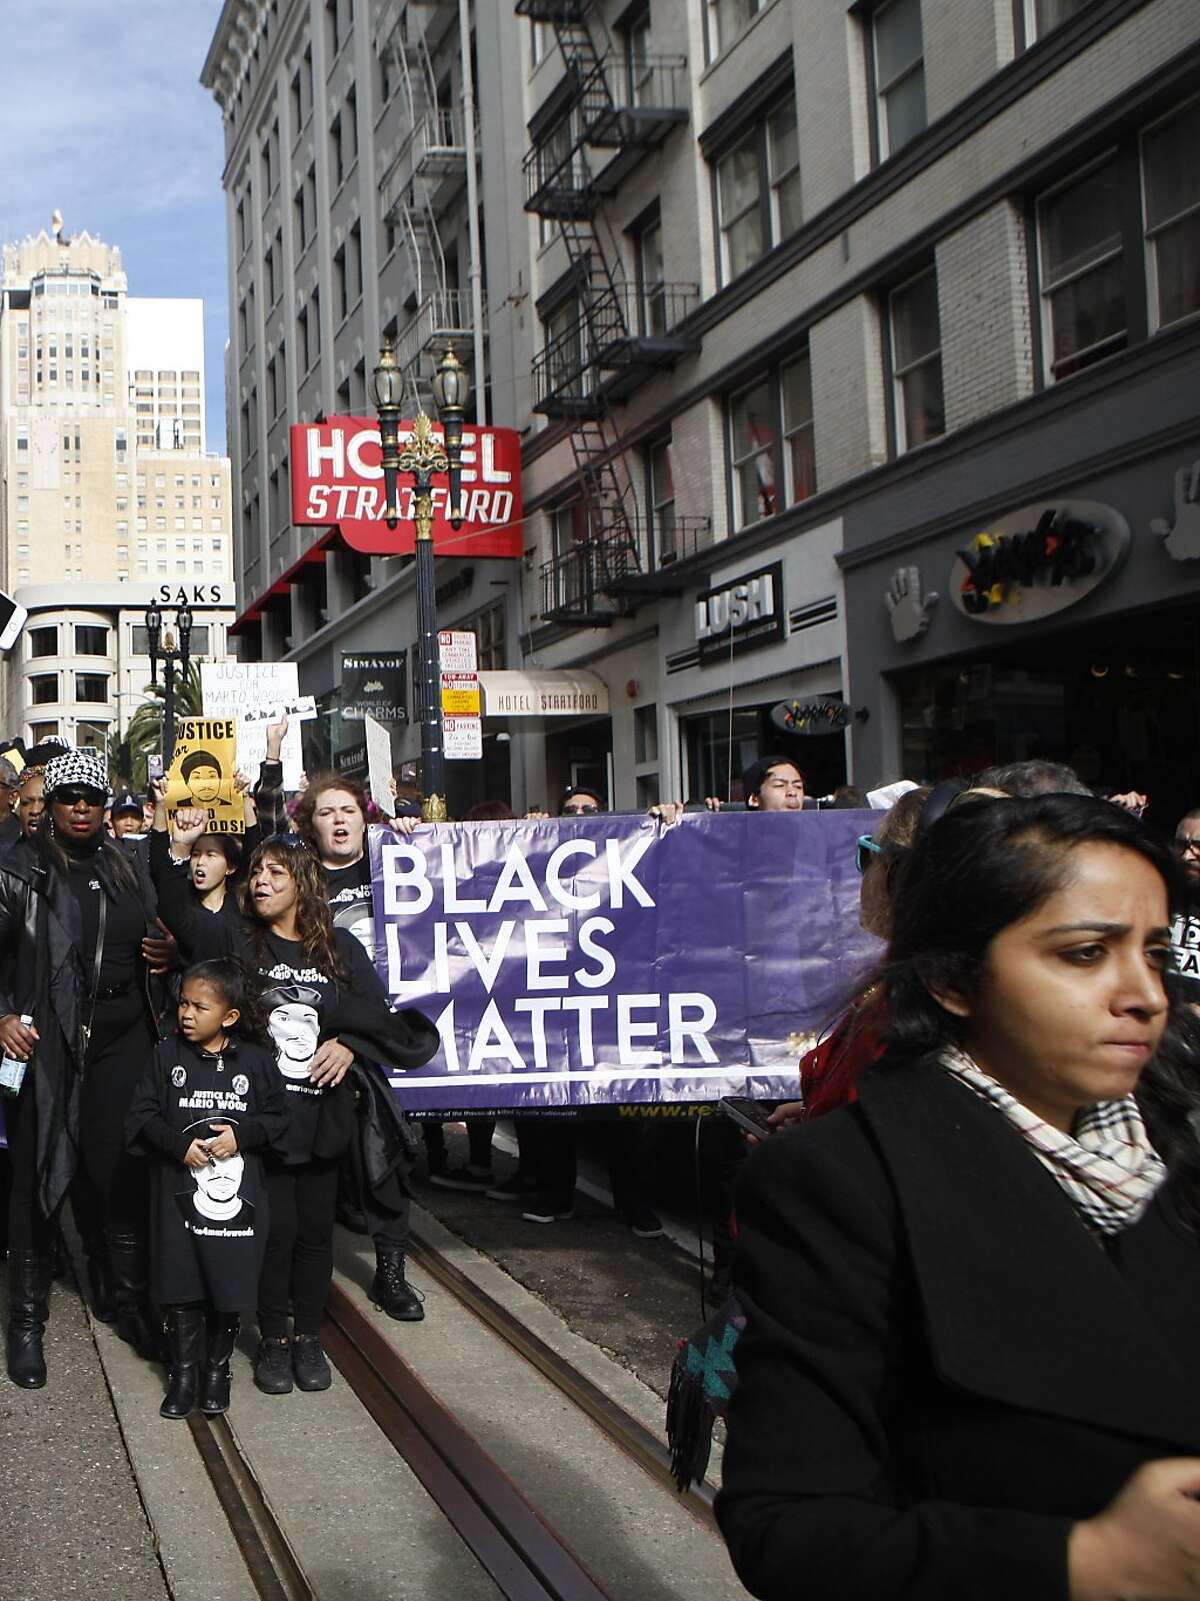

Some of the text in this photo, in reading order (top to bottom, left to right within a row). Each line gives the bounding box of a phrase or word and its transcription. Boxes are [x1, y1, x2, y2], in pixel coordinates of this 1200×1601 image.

[160, 585, 221, 602] SAKS
[695, 574, 774, 640] LUSH
[498, 695, 599, 711] HOTEL STRATFORD
[341, 706, 406, 719] CHARMS
[177, 721, 234, 740] USTICE
[204, 819, 244, 833] OODS!
[381, 837, 656, 916] BLACK
[386, 916, 616, 995] LIVES
[193, 1090, 224, 1100] JUSTICE
[178, 1098, 214, 1109] MARIO
[619, 1104, 720, 1117] www.re
